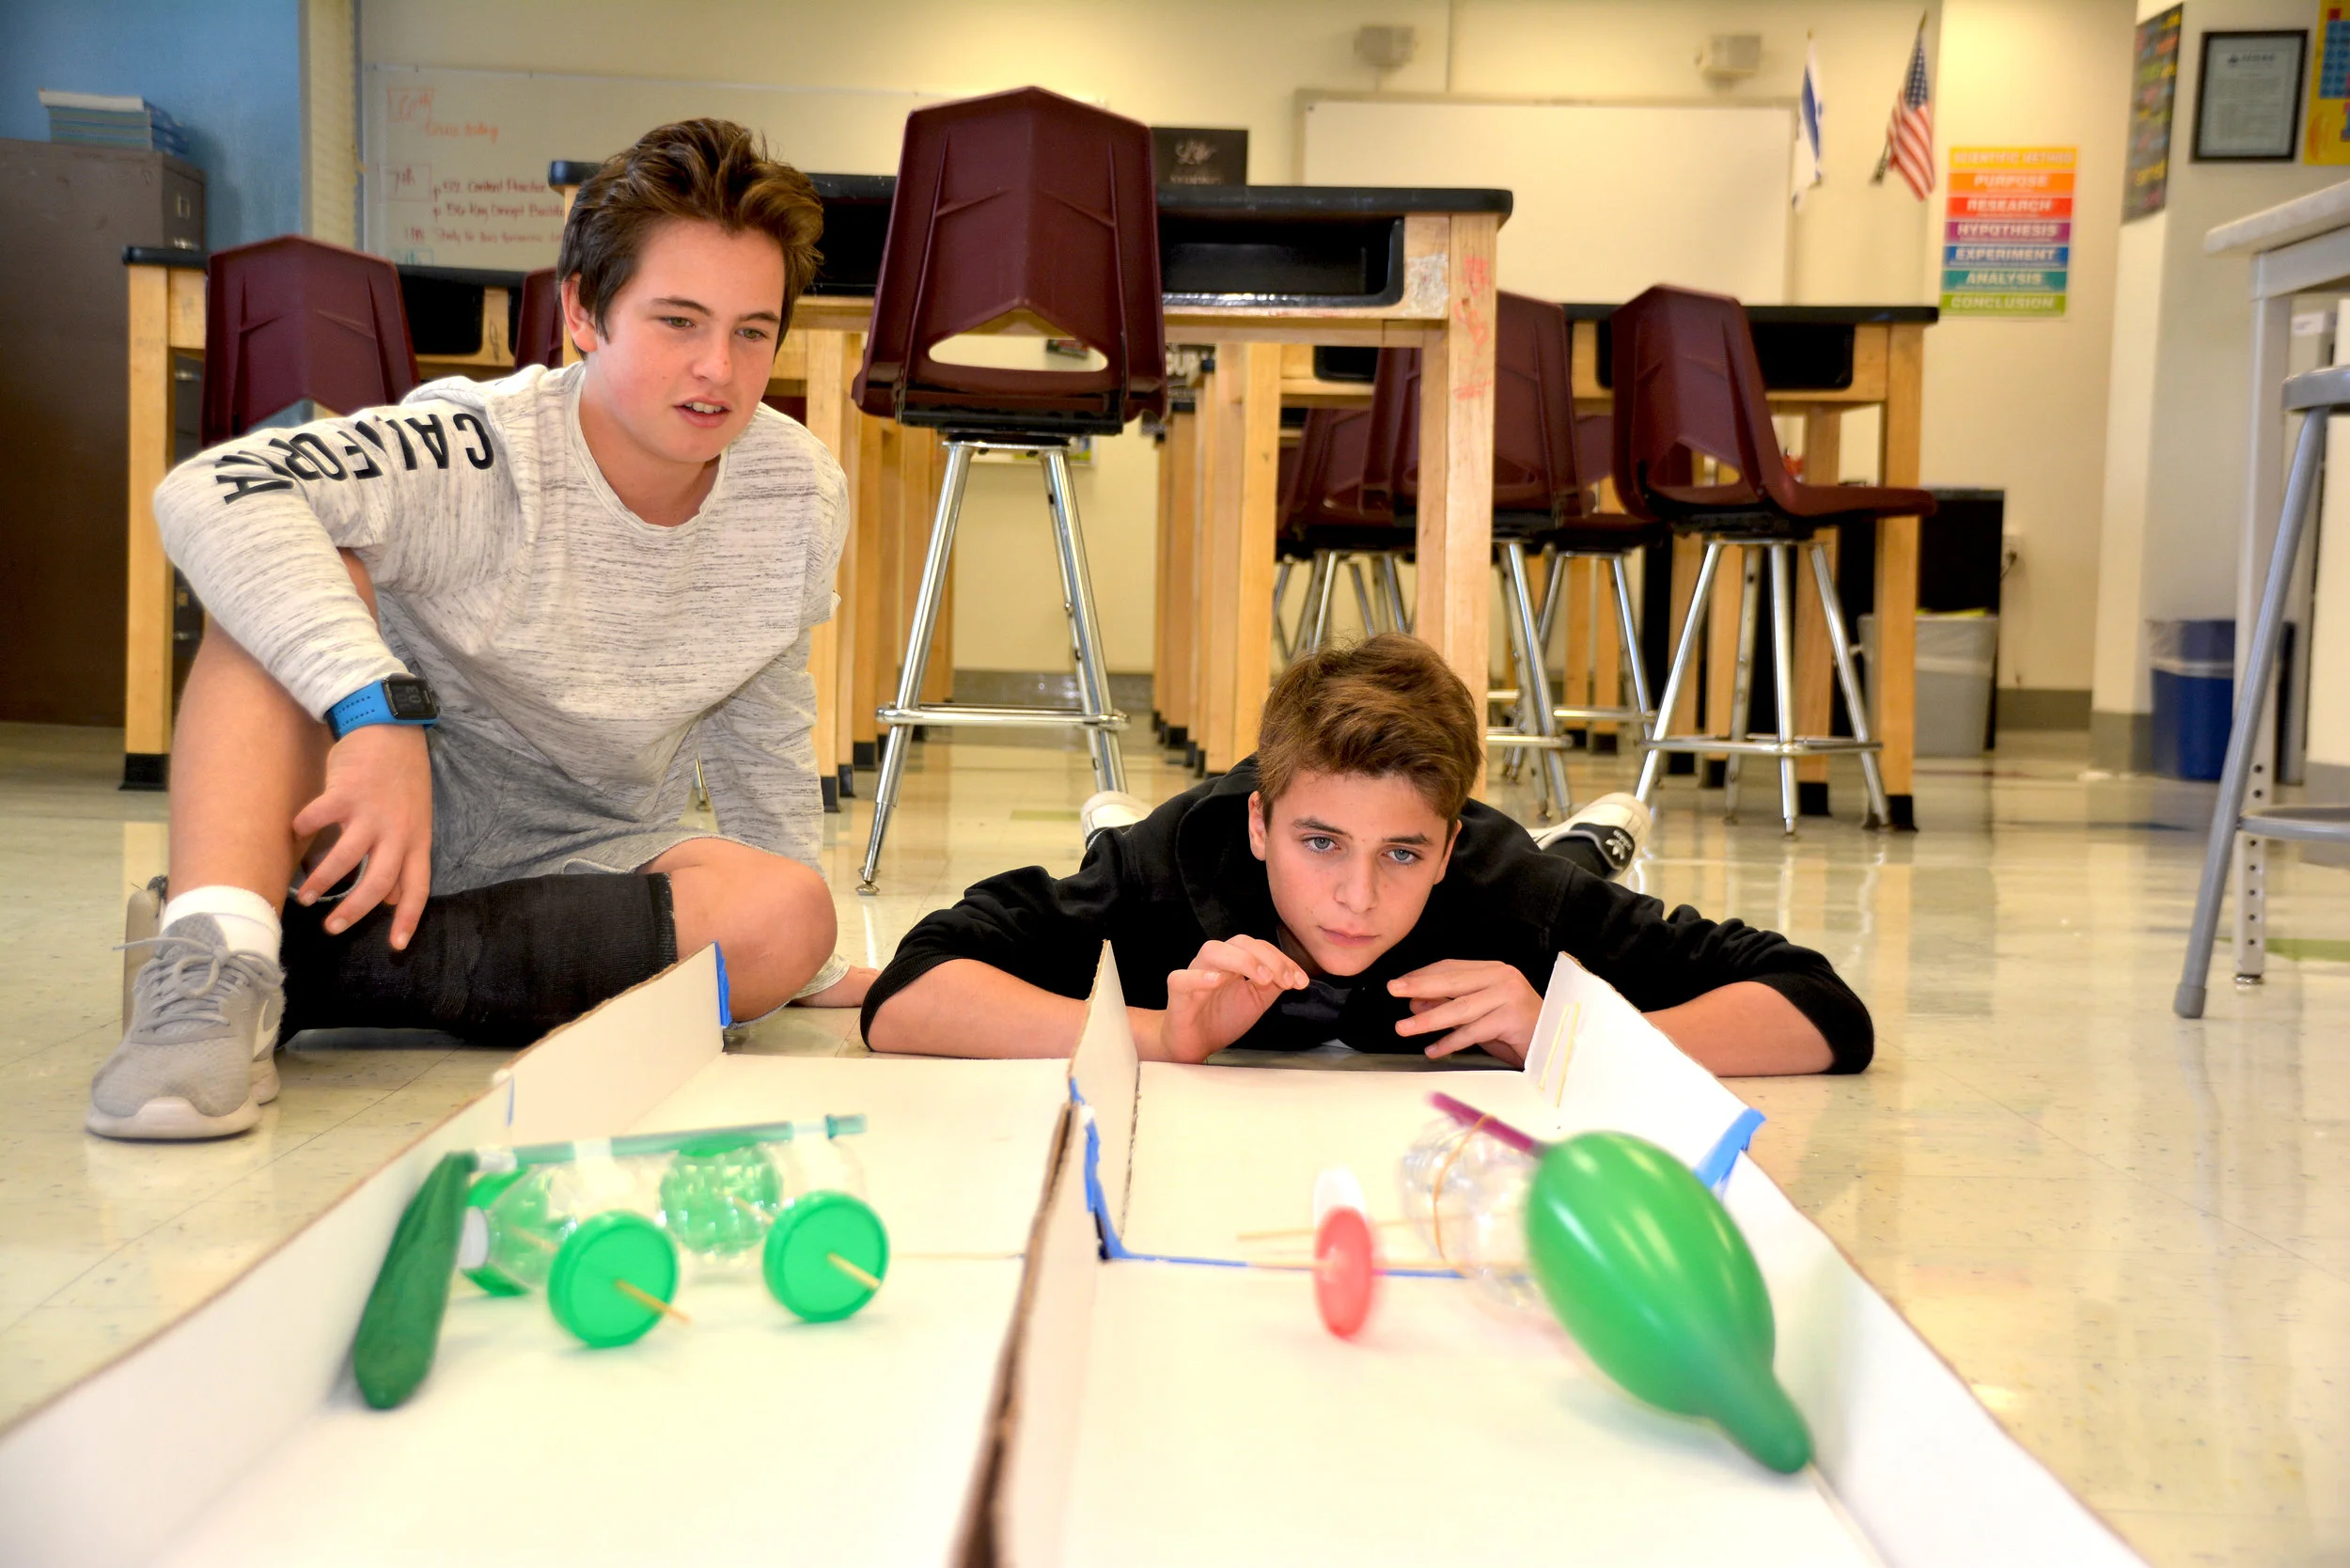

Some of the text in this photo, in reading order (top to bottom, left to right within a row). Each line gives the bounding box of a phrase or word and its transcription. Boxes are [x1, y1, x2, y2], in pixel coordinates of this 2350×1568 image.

[1954, 151, 2073, 165] SCIENTIFIC METHOD
[1974, 175, 2048, 188] PURPOSE
[1966, 199, 2052, 212] RESEARCH
[1957, 223, 2059, 237] HYPOTHESIS
[1955, 248, 2056, 261] EXPERIMENT
[1966, 273, 2043, 286] ANALYSIS
[1951, 296, 2054, 309] CONCLUSION
[215, 414, 494, 505] CALIFORNA
